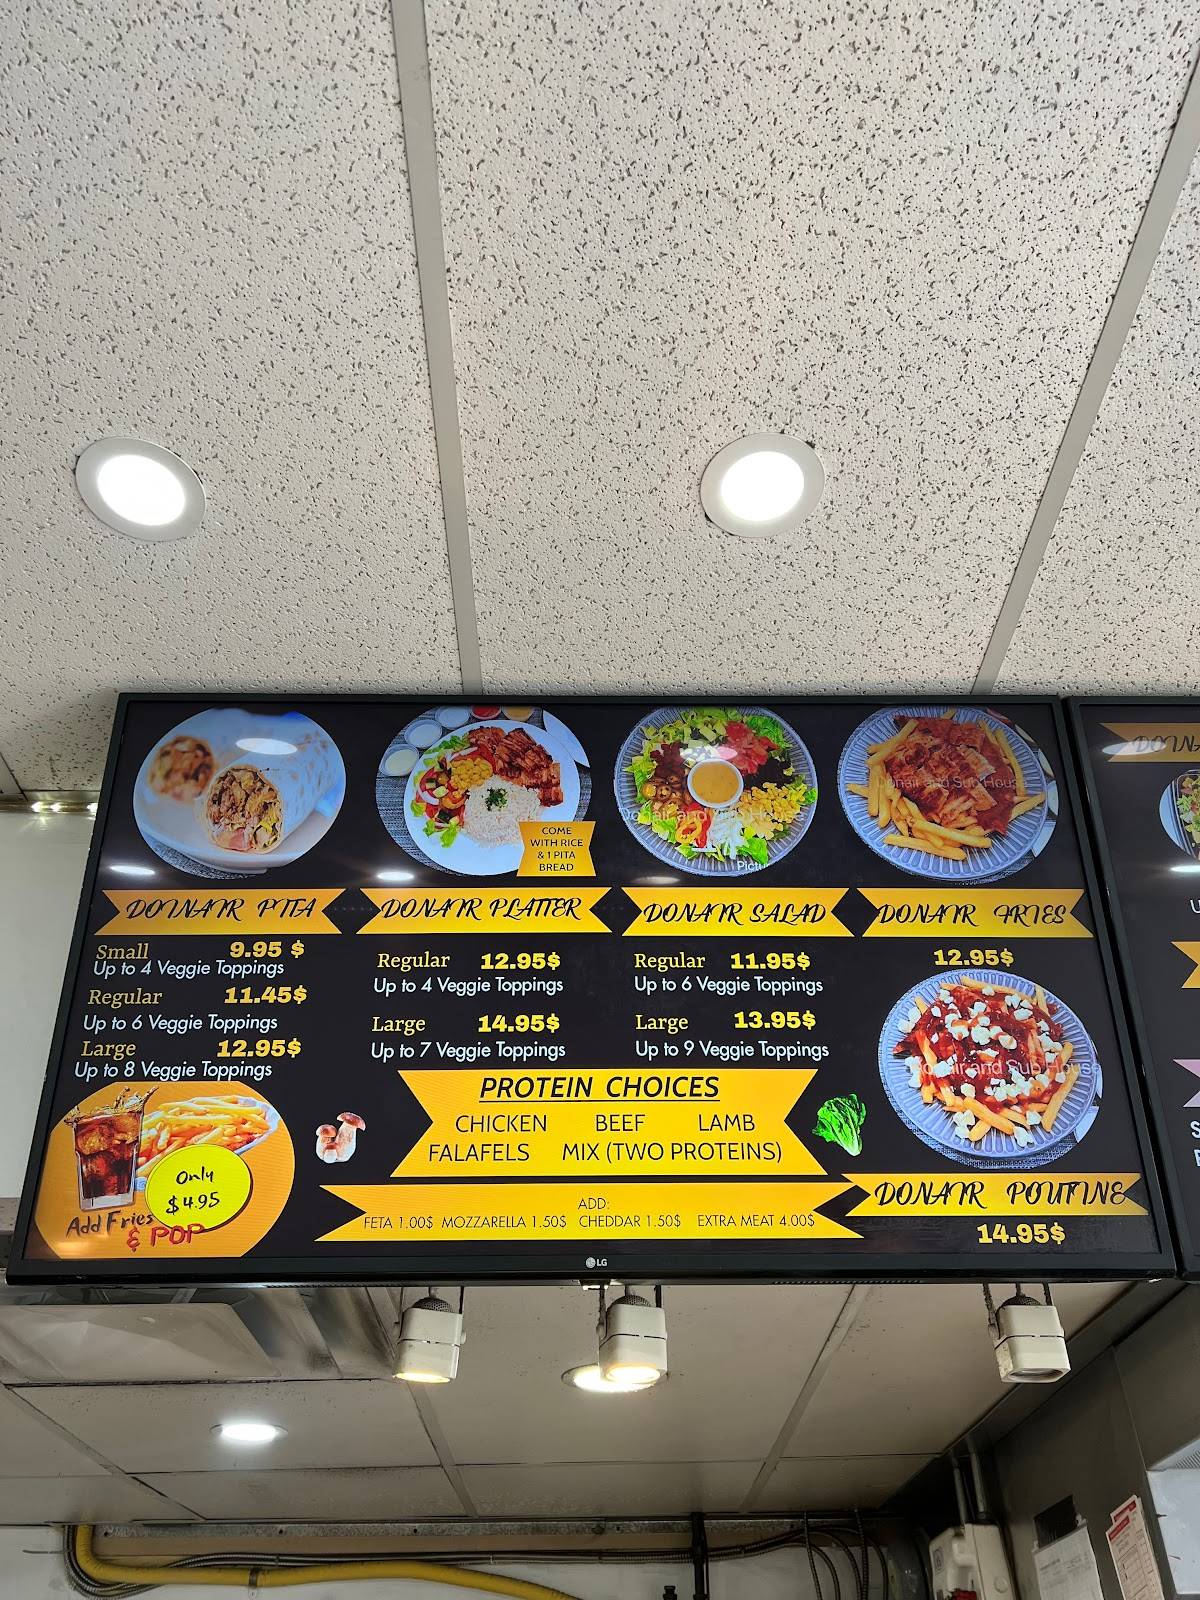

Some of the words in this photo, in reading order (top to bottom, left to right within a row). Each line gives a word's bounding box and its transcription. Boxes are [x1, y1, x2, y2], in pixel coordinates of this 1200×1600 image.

[541, 826, 573, 835] COME
[530, 838, 558, 847] WITH
[560, 838, 584, 847] RICE
[537, 850, 545, 859] &
[547, 851, 551, 859] 1
[553, 851, 576, 859] PITA
[539, 863, 574, 872] BREAD
[257, 897, 317, 918] PITA
[381, 897, 483, 921] DONAIR
[489, 897, 583, 921] PLATTER
[643, 903, 744, 926] DONAIR
[749, 903, 827, 926] SALAD
[877, 903, 980, 927] DONAIR
[95, 943, 150, 960] Small
[229, 941, 283, 958] 9.95
[290, 939, 305, 959] $
[933, 948, 1014, 967] 12.95$
[93, 960, 116, 980] Up
[120, 961, 136, 976] to
[140, 960, 152, 975] 4
[157, 960, 211, 980] Veggie
[215, 960, 285, 980] Toppings
[377, 951, 451, 972] Regular
[480, 951, 561, 971] 12.95$
[634, 952, 706, 972] Regular
[730, 951, 811, 971] 11.95$
[87, 988, 163, 1009] Regular
[224, 984, 308, 1005] 11.45$
[373, 978, 397, 997] Up
[401, 978, 416, 993] to
[421, 978, 432, 993] 4
[437, 977, 491, 996] Veggie
[495, 976, 564, 996] Toppings
[634, 976, 657, 995] Up
[662, 977, 677, 991] to
[681, 977, 692, 992] 6
[696, 976, 751, 996] Veggie
[754, 976, 824, 996] Toppings
[83, 1014, 106, 1034] Up
[111, 1015, 127, 1030] to
[131, 1014, 143, 1030] 6
[149, 1014, 203, 1035] Veggie
[207, 1014, 278, 1034] Toppings
[371, 1016, 426, 1036] Large
[477, 1013, 560, 1034] 14.95$
[635, 1014, 689, 1034] Large
[734, 1010, 816, 1031] 13.95$
[81, 1040, 137, 1061] Large
[216, 1037, 302, 1059] 12.95$
[371, 1042, 394, 1063] Up
[399, 1043, 415, 1058] to
[419, 1042, 432, 1058] 7
[436, 1041, 491, 1063] Veggie
[495, 1041, 566, 1062] Toppings
[635, 1040, 659, 1061] Up
[663, 1042, 679, 1057] to
[683, 1040, 695, 1057] 9
[699, 1040, 754, 1061] Veggie
[758, 1041, 830, 1062] Toppings
[74, 1061, 98, 1082] Up
[103, 1062, 119, 1078] to
[123, 1061, 135, 1077] 8
[140, 1060, 196, 1082] Veggie
[201, 1060, 273, 1081] Toppings
[480, 1076, 594, 1098] PROTEIN
[606, 1076, 720, 1098] CHOICES
[455, 1115, 547, 1133] CHICKEN
[595, 1114, 646, 1132] BEEF
[698, 1114, 755, 1131] LAMB
[429, 1143, 530, 1162] FALAFELS
[562, 1142, 600, 1161] MIX
[606, 1142, 664, 1163] (TWO
[671, 1141, 782, 1163] PROTEINS)
[176, 1166, 214, 1185] Only
[577, 1197, 610, 1210] ADD:
[874, 1181, 988, 1210] DONAIR
[1006, 1180, 1127, 1207] POUTINE
[66, 1216, 101, 1239] Add
[107, 1210, 154, 1232] Fries
[364, 1216, 393, 1229] FETA
[399, 1216, 434, 1229] 1.00$
[442, 1215, 526, 1229] MOZZARELLA
[531, 1215, 567, 1228] 1.50$
[579, 1215, 641, 1228] CHEDDAR
[646, 1215, 681, 1228] 1.50$
[697, 1214, 737, 1228] EXTRA
[740, 1214, 774, 1227] MEAT
[779, 1214, 815, 1228] 4.00$
[150, 1223, 205, 1247] POP
[976, 1221, 1066, 1245] 14.95$
[596, 1258, 608, 1268] LG
